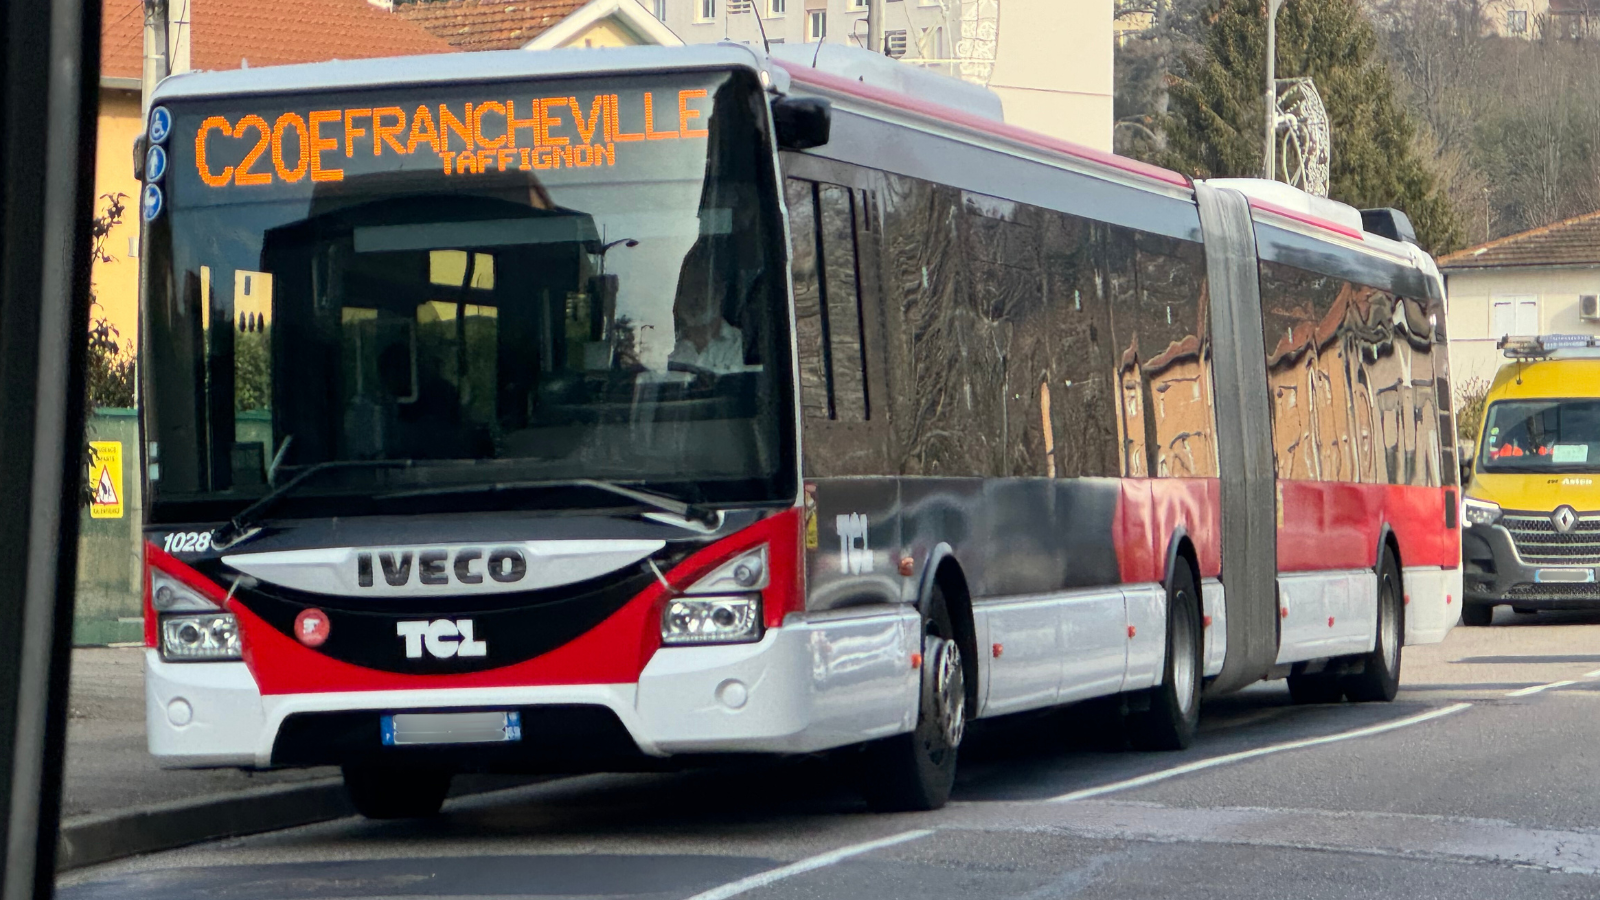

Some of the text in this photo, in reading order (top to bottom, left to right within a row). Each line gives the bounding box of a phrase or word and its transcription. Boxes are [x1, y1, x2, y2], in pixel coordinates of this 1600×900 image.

[195, 89, 709, 187] C20E FRANCHEVILLE
[438, 143, 616, 175] TAFFIGNON
[164, 531, 212, 552] 1028
[357, 547, 527, 588] IVECO
[396, 618, 487, 659] TCL
